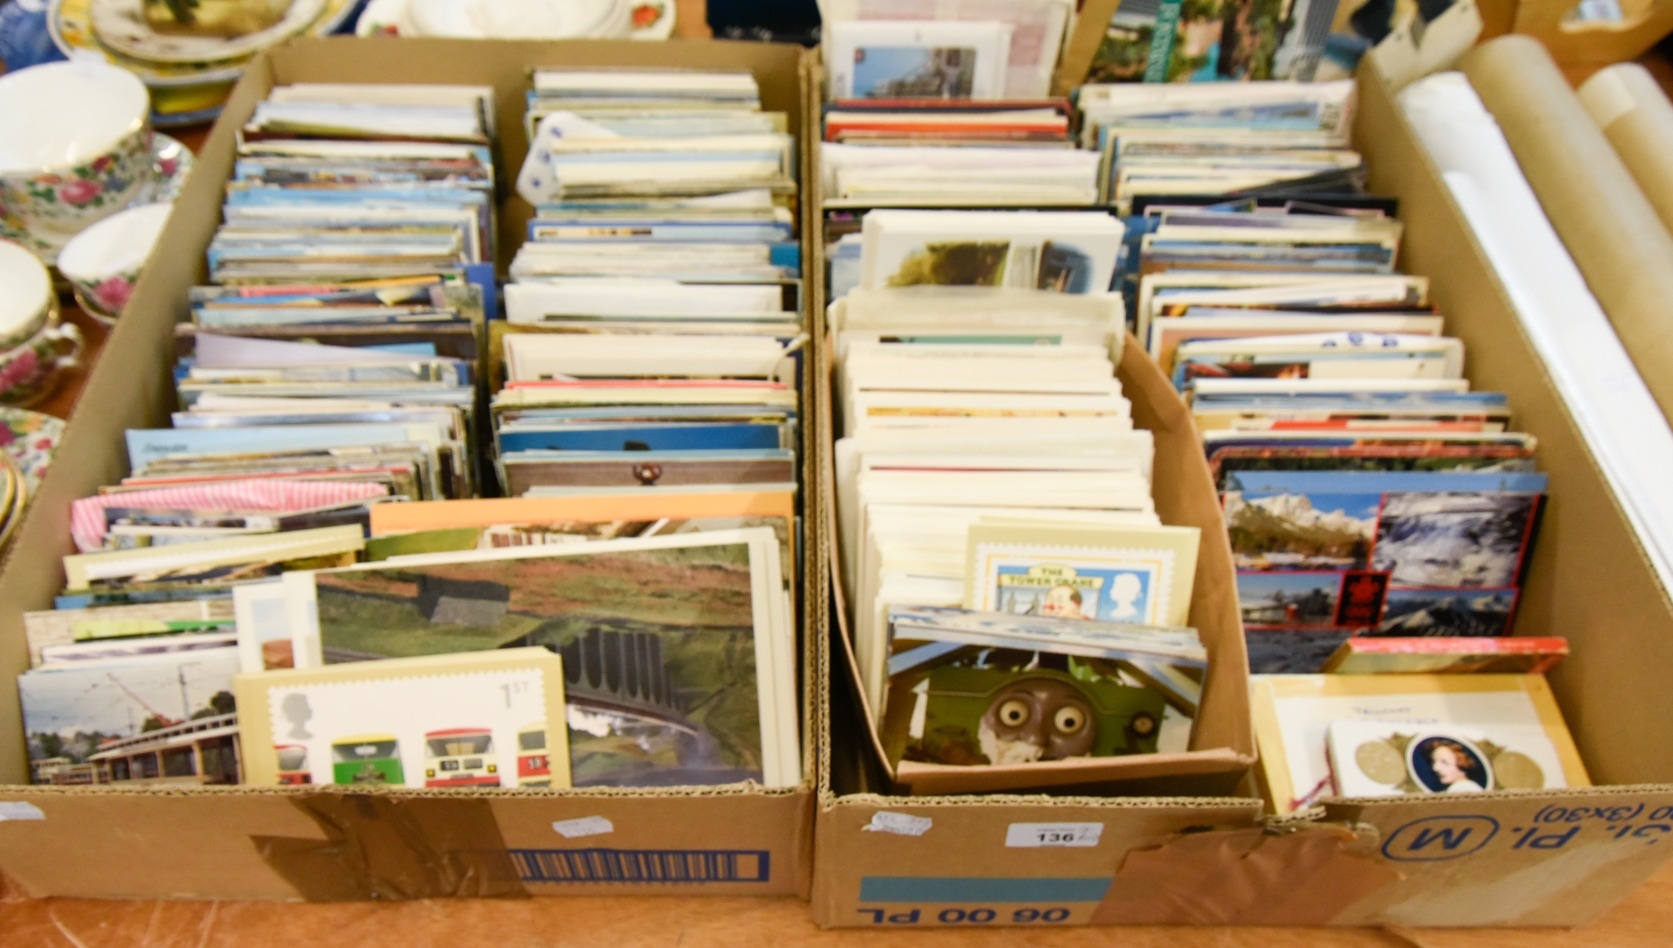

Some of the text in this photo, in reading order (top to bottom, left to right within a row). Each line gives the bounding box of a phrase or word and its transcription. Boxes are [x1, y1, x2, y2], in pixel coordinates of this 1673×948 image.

[1042, 567, 1063, 576] THE
[1009, 576, 1094, 588] TOWER CRANE
[1534, 803, 1673, 823] 0 (3x30)
[1037, 833, 1074, 842] 136
[1408, 828, 1473, 850] M
[857, 908, 1070, 924] 06 00 PL
